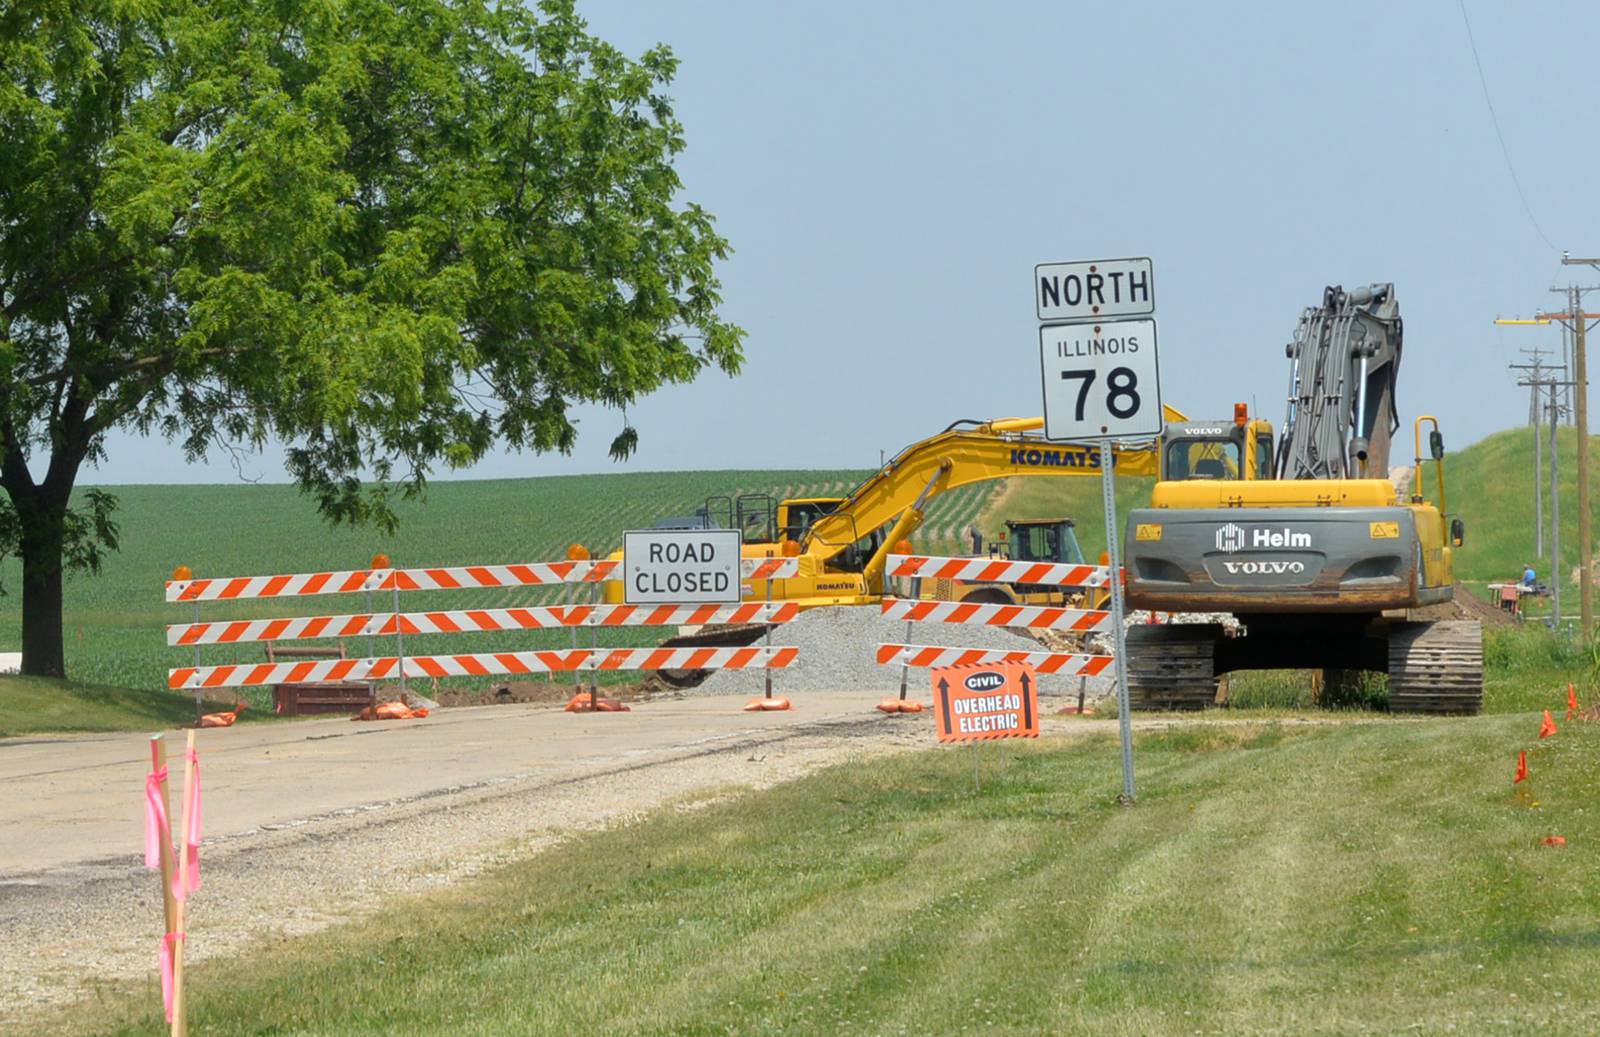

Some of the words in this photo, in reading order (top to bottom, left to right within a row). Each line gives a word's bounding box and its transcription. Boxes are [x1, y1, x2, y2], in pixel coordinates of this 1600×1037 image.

[1041, 270, 1148, 307] NORTH
[1057, 337, 1139, 357] ILLINOIS
[1061, 366, 1141, 422] 78
[1253, 528, 1311, 547] Helm
[650, 543, 715, 563] ROAD
[1223, 561, 1305, 574] VOLVO
[636, 572, 729, 593] CLOSED
[967, 676, 1002, 688] CIVIL
[954, 694, 1020, 715] OVERHEAD
[960, 713, 1018, 733] ELECTRIC
